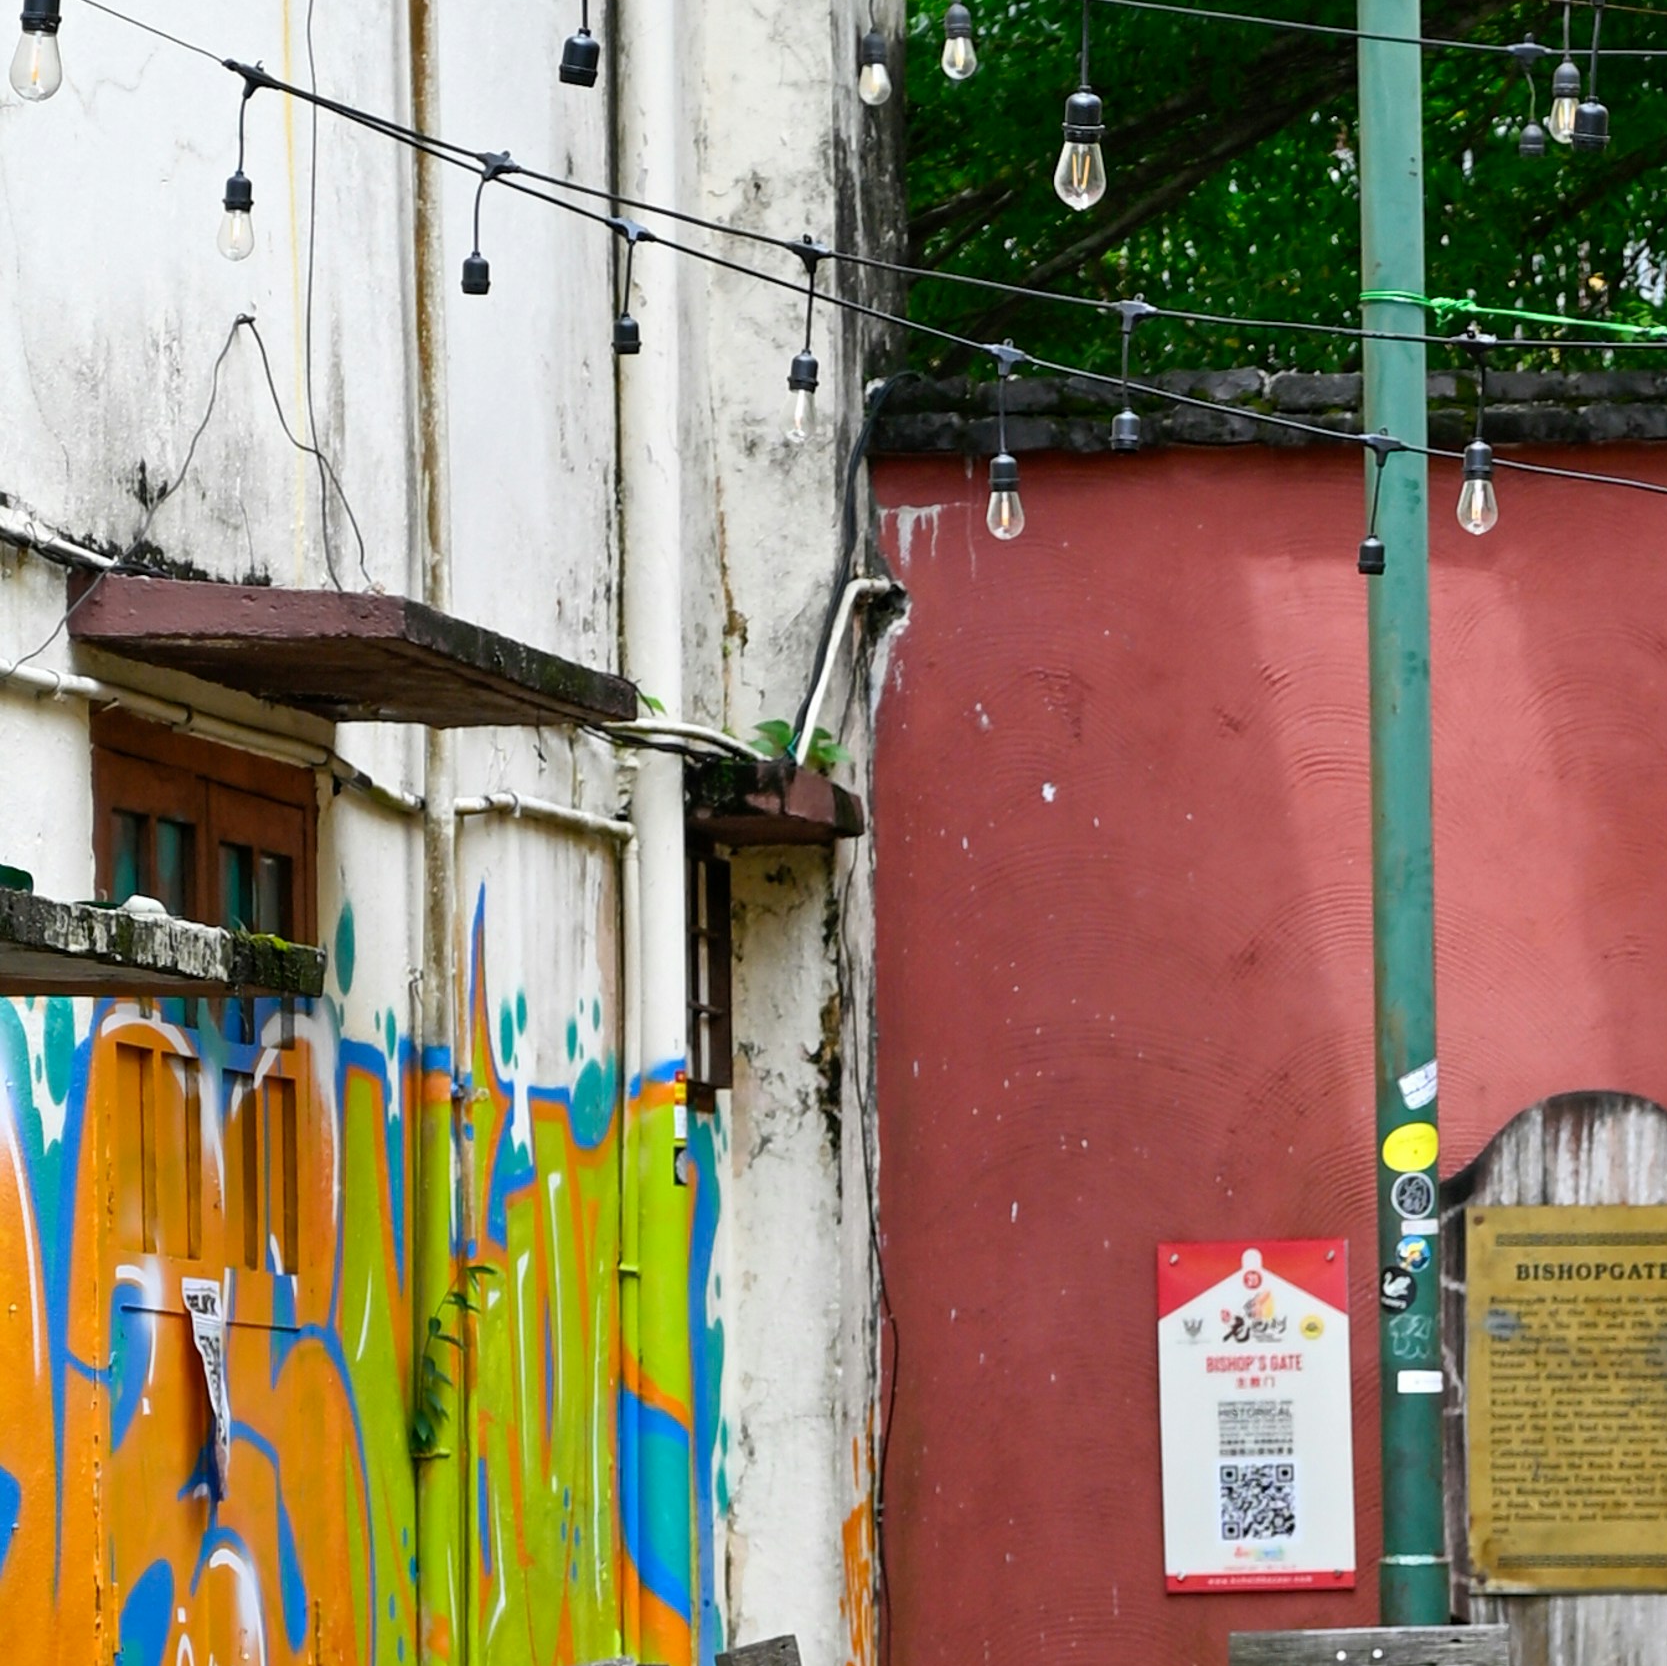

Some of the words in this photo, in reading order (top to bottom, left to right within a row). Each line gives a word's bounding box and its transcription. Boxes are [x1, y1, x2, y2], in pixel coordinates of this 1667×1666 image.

[1206, 1355, 1266, 1373] BISHOP'S
[1270, 1353, 1303, 1371] GATE
[1218, 1407, 1292, 1419] HISTORICAL
